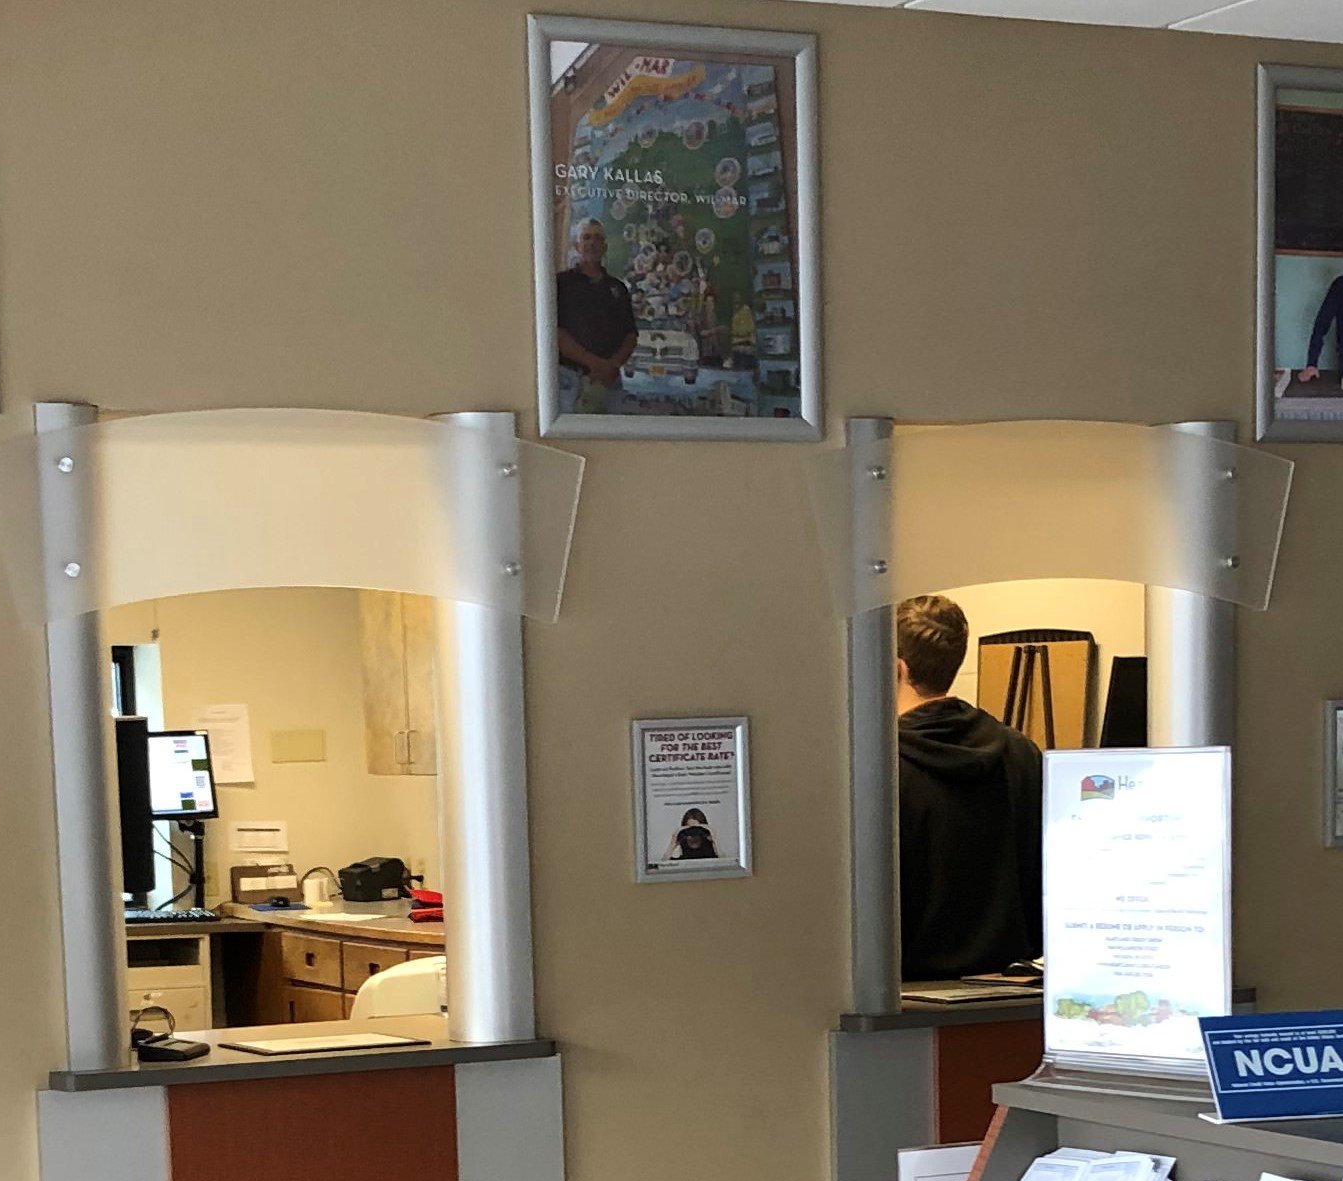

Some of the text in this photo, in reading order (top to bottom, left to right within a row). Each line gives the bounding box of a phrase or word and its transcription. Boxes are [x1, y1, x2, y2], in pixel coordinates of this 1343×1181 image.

[555, 164, 598, 180] GARY
[555, 185, 622, 199] EXECUTIVE
[649, 731, 733, 742] TIRED OF LOOKING
[661, 741, 723, 751] FOR THE BEST
[649, 752, 707, 763] CERTIFICATE
